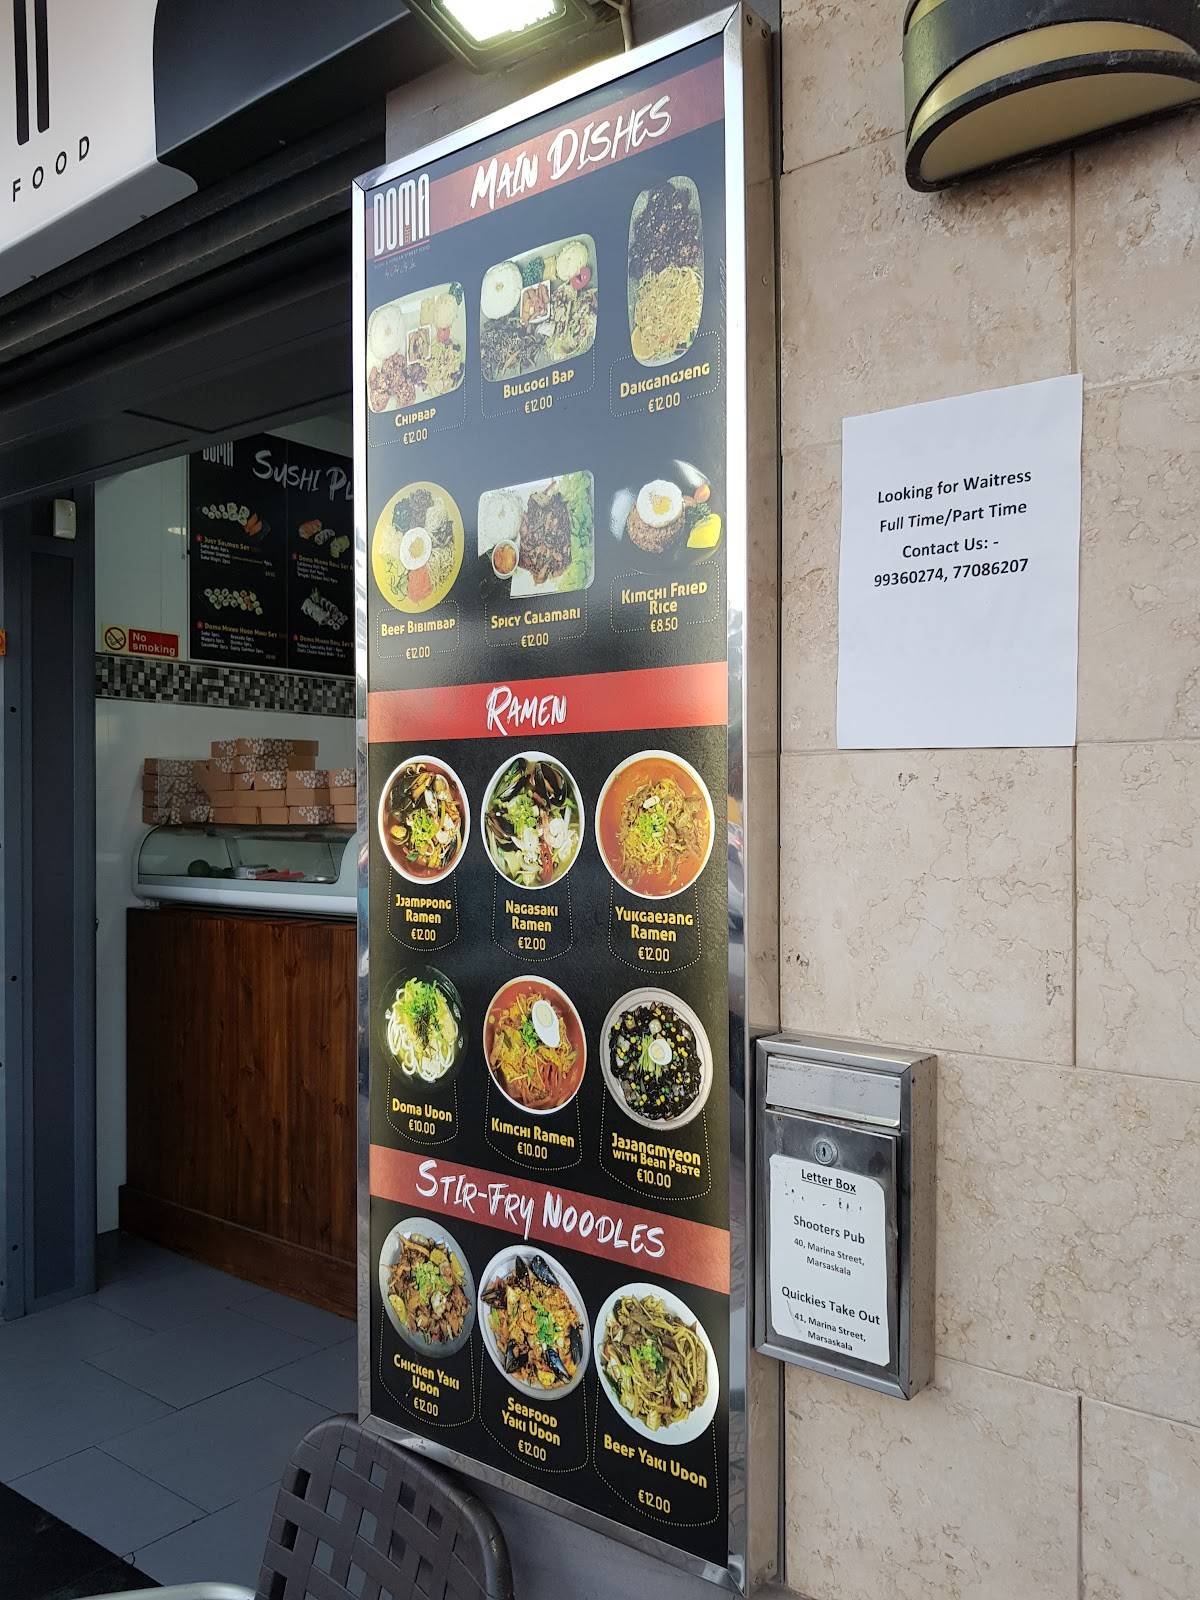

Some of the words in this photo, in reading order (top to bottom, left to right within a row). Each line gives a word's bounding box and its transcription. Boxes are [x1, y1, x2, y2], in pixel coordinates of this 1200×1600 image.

[470, 151, 538, 209] MAIN
[547, 95, 672, 180] DISHES
[13, 136, 90, 202] FOOD
[373, 173, 430, 256] DOMA
[877, 485, 932, 504] Looking
[937, 481, 959, 495] for
[963, 470, 1032, 491] Waitress
[879, 516, 903, 533] Full
[908, 507, 984, 528] Time/Part
[989, 502, 1027, 517] Time
[902, 539, 959, 558] Contact
[964, 537, 988, 551] Us:
[873, 567, 948, 588] 99360274,
[953, 558, 1029, 579] 77086207
[649, 600, 678, 615] Rice
[381, 624, 405, 637] Beef
[491, 615, 522, 630] Spicy
[650, 617, 678, 632] €8.50
[132, 632, 147, 642] No
[132, 643, 176, 657] smoking
[486, 685, 567, 736] RAMEN
[405, 909, 441, 924] Ramen
[511, 916, 552, 932] Ramen
[631, 924, 677, 942] Ramen
[392, 1097, 422, 1116] Doma
[424, 1104, 452, 1123] Udon
[408, 1119, 436, 1136] €10.00
[491, 1117, 531, 1138] Kimchi
[533, 1126, 575, 1148] Ramen
[517, 1142, 548, 1160] €10.00
[640, 1152, 666, 1170] Bean
[637, 1168, 671, 1188] €10.00
[801, 1168, 832, 1186] Letter
[836, 1178, 857, 1193] Box
[416, 1159, 535, 1240] STIR-FRY
[542, 1191, 665, 1258] NOODLES
[793, 1215, 840, 1238] Shooters
[843, 1229, 865, 1244] Pub
[793, 1238, 806, 1249] 40,
[807, 1242, 835, 1256] Marina
[837, 1250, 865, 1266] Street,
[806, 1256, 851, 1276] Marsaskala
[781, 1286, 826, 1309] Quickies
[829, 1300, 855, 1318] Take
[858, 1310, 880, 1325] Out
[794, 1312, 806, 1324] 41,
[808, 1317, 836, 1332] Marina
[838, 1327, 866, 1342] Street,
[808, 1331, 853, 1351] Marsaskala
[393, 1353, 435, 1380] Chicken
[437, 1368, 460, 1391] Yaki
[412, 1375, 440, 1398] Udon
[413, 1397, 439, 1417] €12.00
[507, 1397, 557, 1428] Seafood
[502, 1409, 526, 1433] Yaki
[529, 1420, 561, 1447] Udon
[518, 1439, 547, 1462] €12.00
[604, 1434, 635, 1458] Beef
[638, 1447, 667, 1472] Yaki
[670, 1460, 707, 1489] Udon
